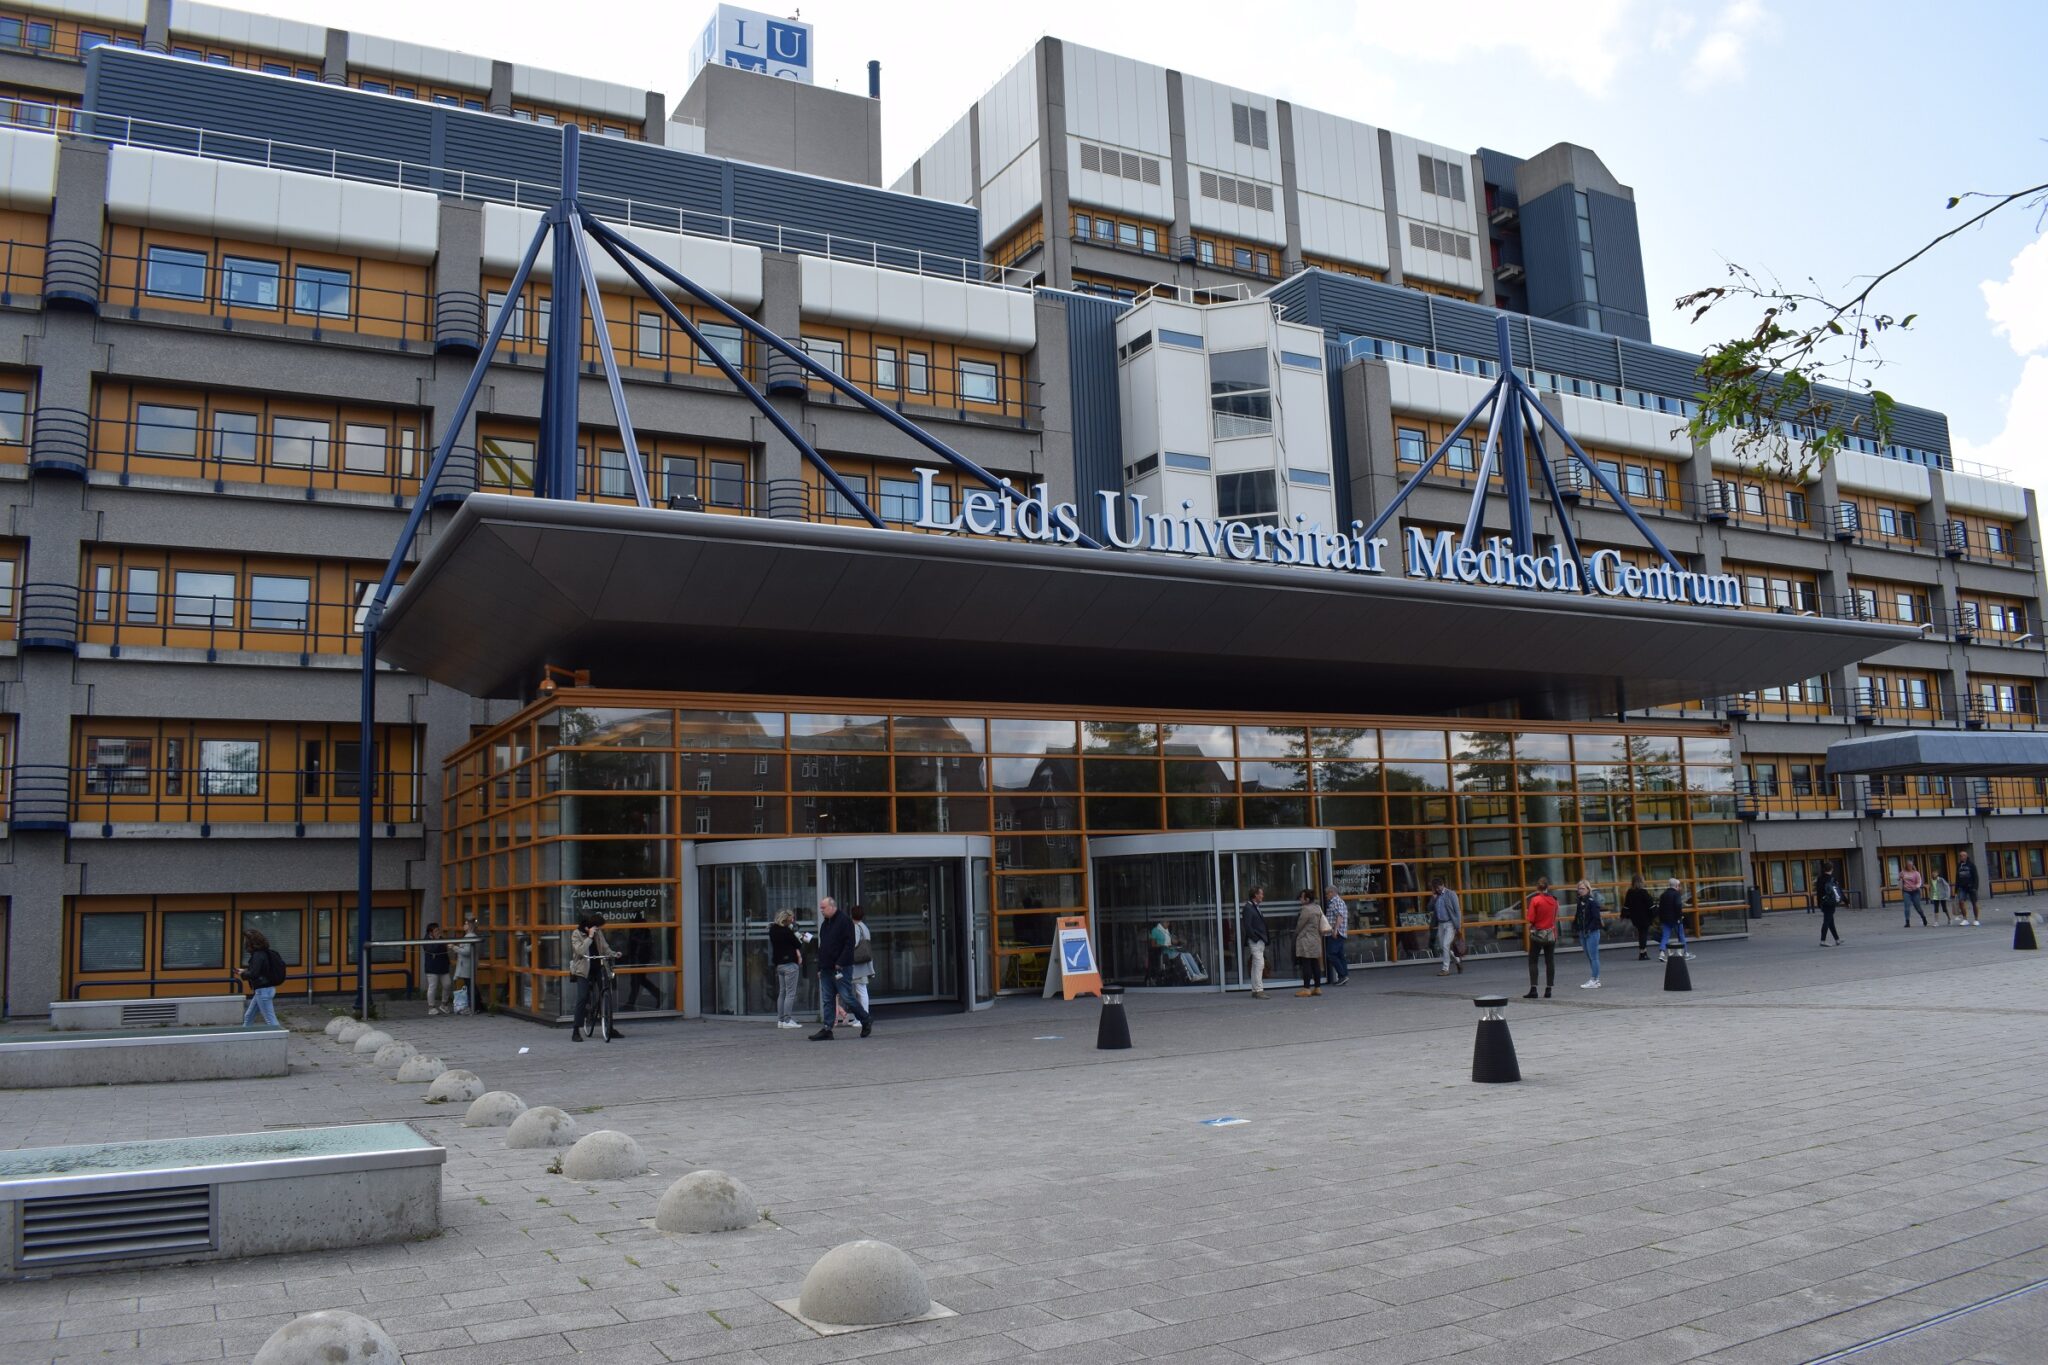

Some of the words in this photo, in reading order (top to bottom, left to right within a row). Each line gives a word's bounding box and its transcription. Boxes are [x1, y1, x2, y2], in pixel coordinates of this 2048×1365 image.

[912, 467, 1080, 543] Leids
[1096, 489, 1389, 573] Universitair
[1405, 525, 1581, 592] Medisch
[1589, 549, 1744, 608] Centrum
[571, 888, 667, 898] Ziekenhuisgebouw
[582, 899, 648, 909] Albinusdreef
[651, 898, 656, 907] 2
[640, 910, 645, 919] 1
